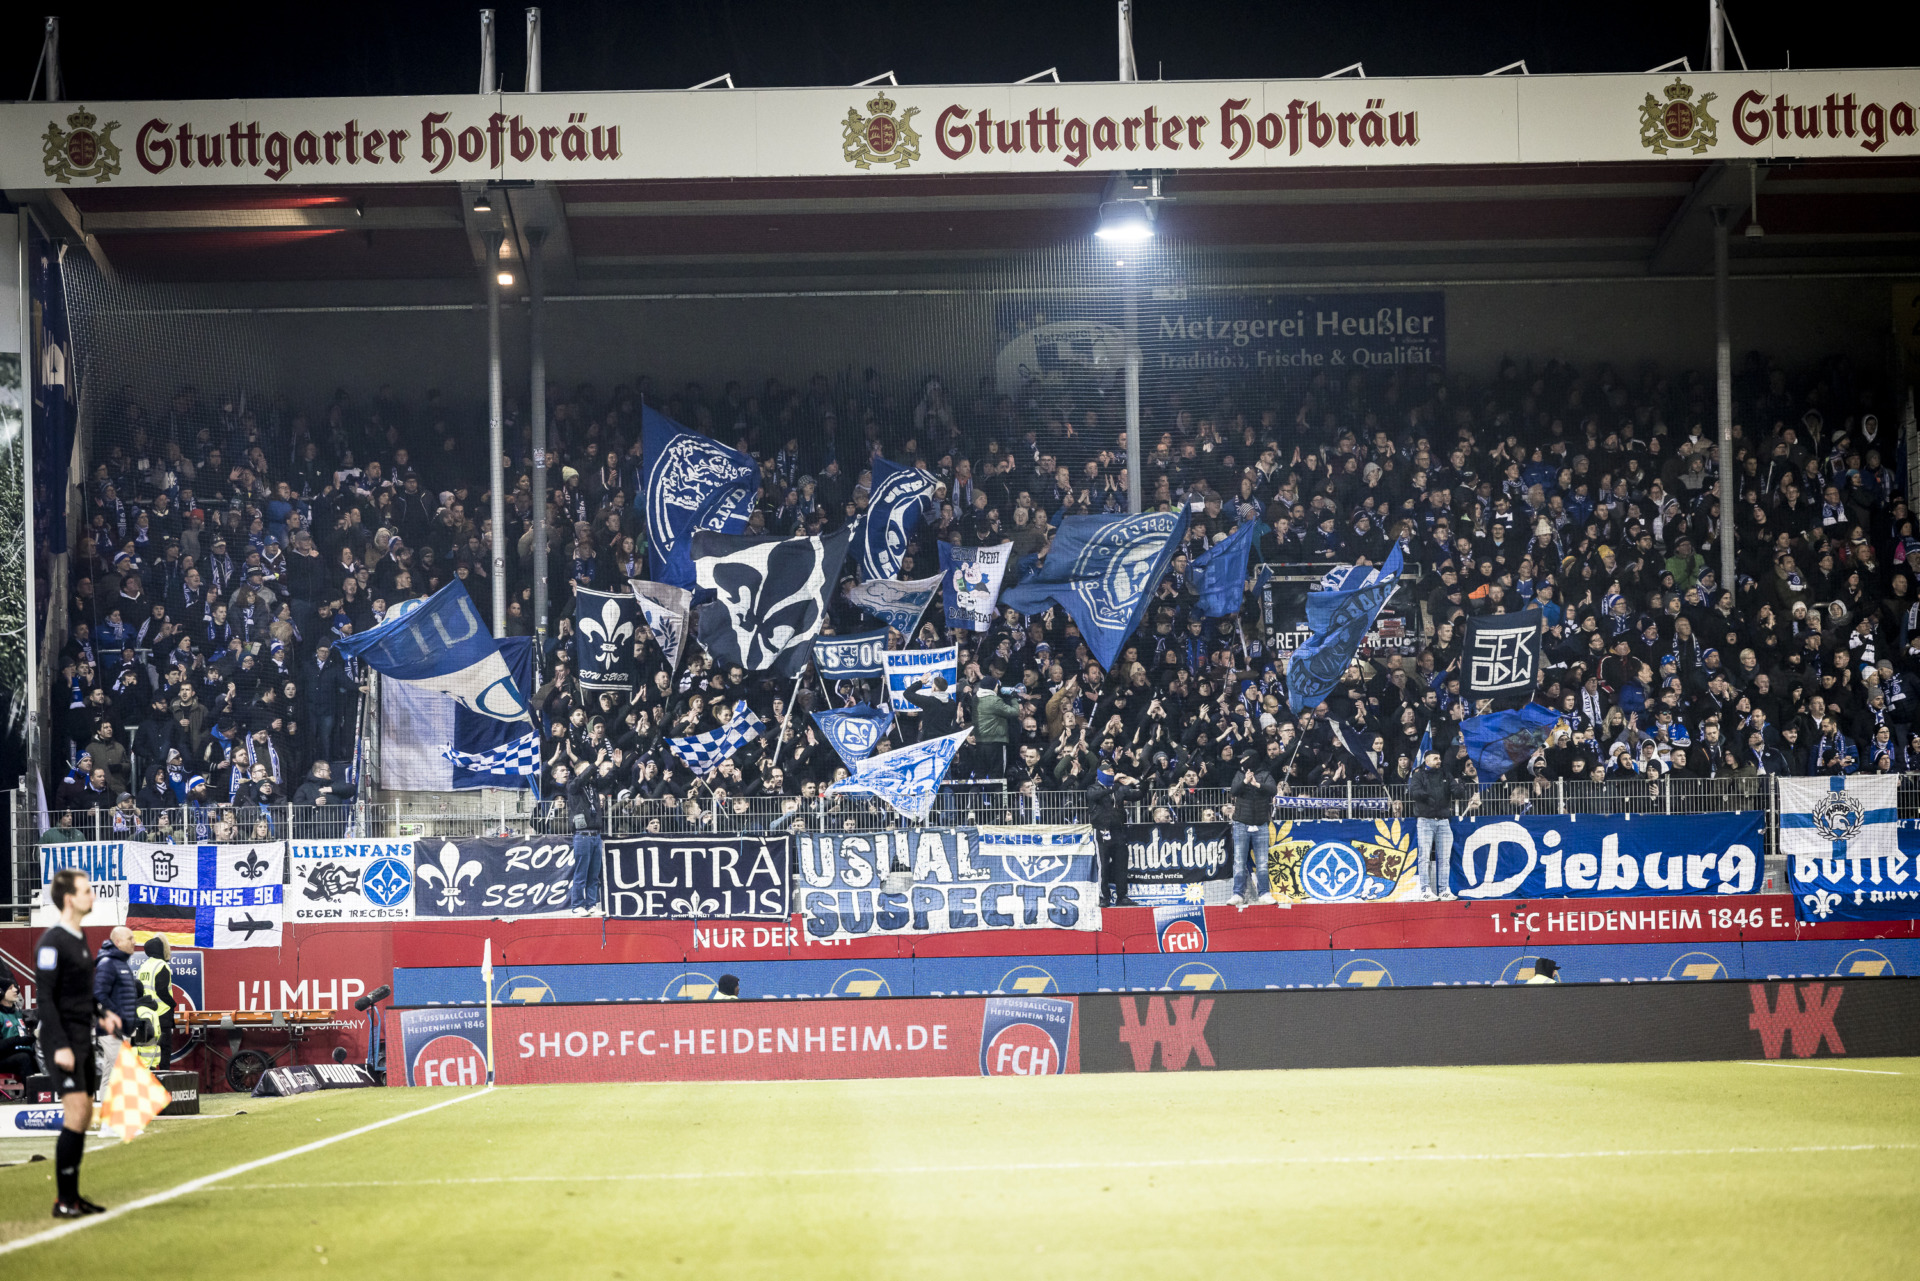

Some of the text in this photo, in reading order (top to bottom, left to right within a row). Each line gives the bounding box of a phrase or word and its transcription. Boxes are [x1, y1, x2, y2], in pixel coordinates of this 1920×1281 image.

[935, 98, 1420, 167] Stuttgarter Hofbräu
[136, 112, 622, 181] Stuttgarter Hofbräu
[1158, 308, 1434, 346] Metzgerei Heußler
[1257, 349, 1324, 367] Frische
[1330, 349, 1346, 365] &
[1352, 346, 1431, 368] Qualität
[579, 668, 601, 680] ROW
[292, 844, 412, 859] LILIENFANS
[608, 835, 782, 889] ULTRÀ
[800, 830, 991, 888] USUAL
[1458, 821, 1756, 898] Dieburg
[91, 884, 121, 899] TADT
[139, 886, 274, 907] SV HOINERS 98
[482, 879, 572, 908] SEVE
[296, 909, 342, 918] GEGEN
[805, 883, 1080, 938] SUSPECTS
[1491, 914, 1507, 933] 1.
[1514, 913, 1540, 932] FC
[1548, 908, 1702, 932] HEIDENHEIM
[1707, 907, 1763, 929] 1846
[693, 928, 746, 949] NUR
[753, 927, 800, 948] DER
[1168, 931, 1199, 953] FCH
[175, 967, 197, 976] 1846
[463, 1020, 485, 1030] 1846
[1046, 1014, 1066, 1023] 1846
[519, 1024, 948, 1059] SHOP.FC-HEIDENHEIM.DE
[997, 1043, 1050, 1075] FCH
[424, 1056, 478, 1087] FCH
[171, 1089, 197, 1102] BUNDESLIGA
[27, 1110, 65, 1119] VART
